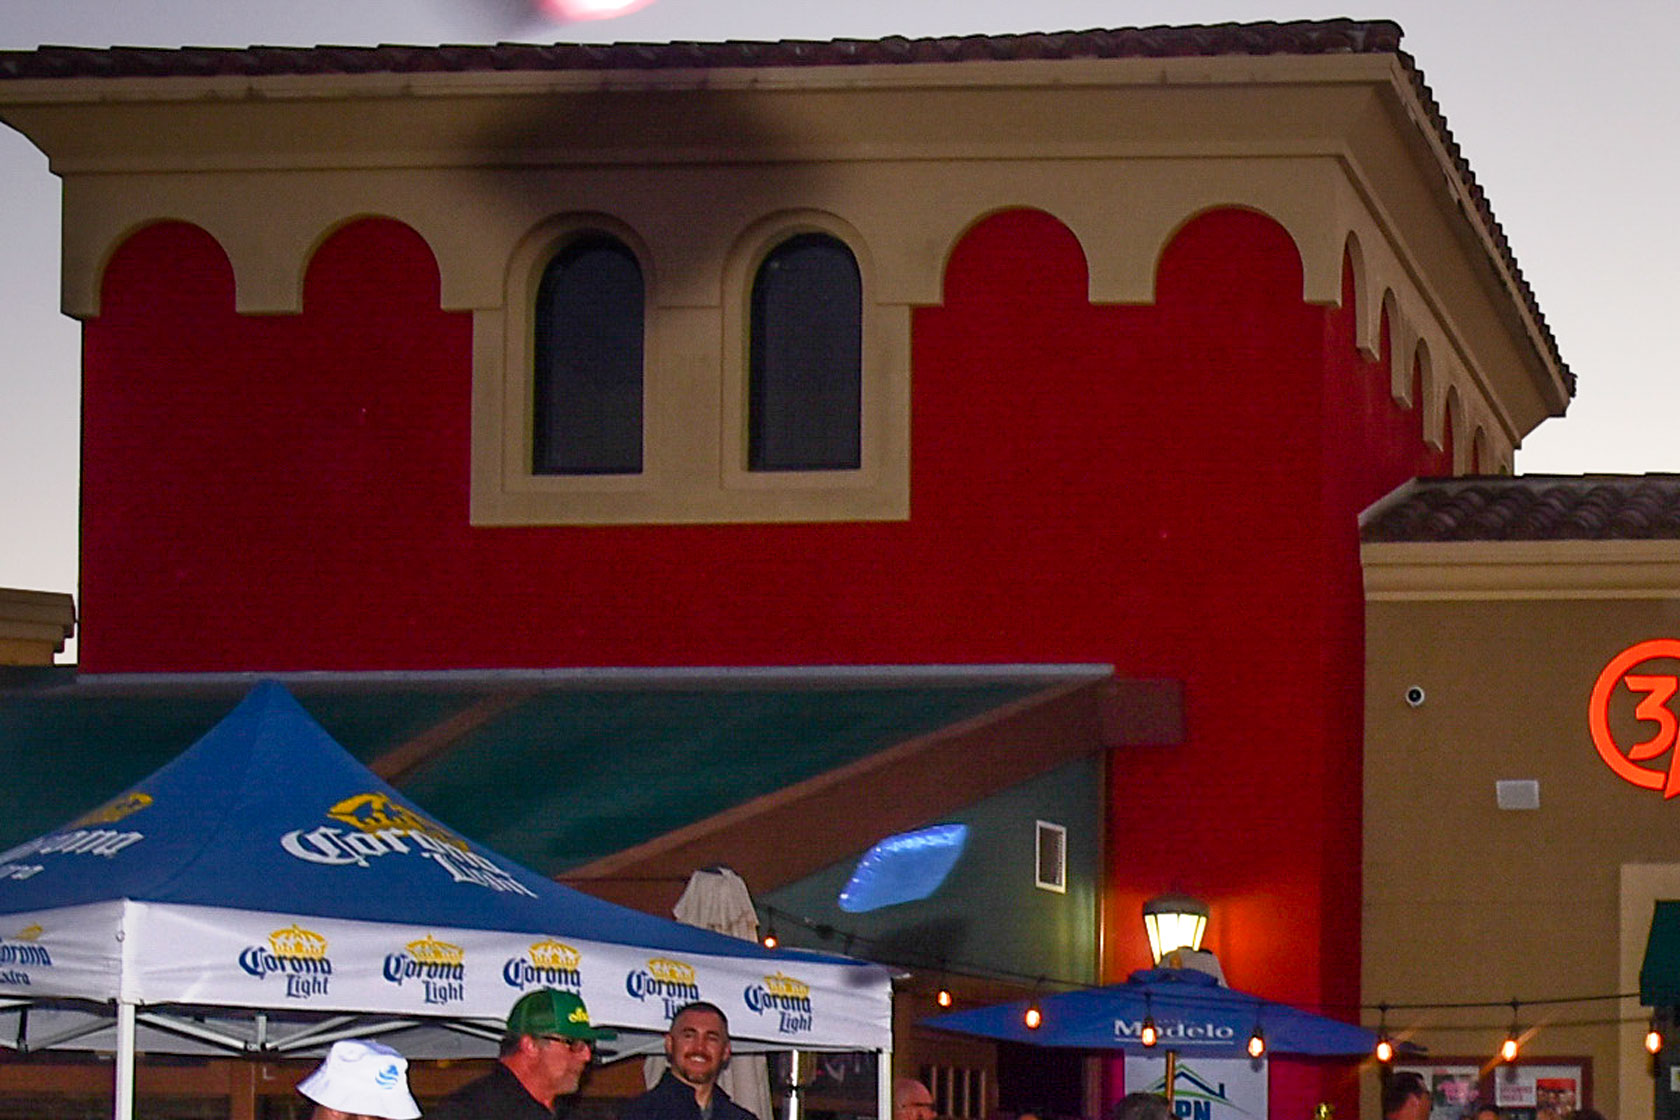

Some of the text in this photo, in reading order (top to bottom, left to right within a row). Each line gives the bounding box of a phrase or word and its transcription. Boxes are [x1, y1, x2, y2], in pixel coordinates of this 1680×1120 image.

[280, 826, 512, 879] Corona
[0, 936, 53, 967] orona
[239, 946, 332, 980] Corona
[383, 952, 464, 986] Corona
[503, 958, 581, 991] Corona
[627, 969, 699, 1002] Corona
[286, 974, 328, 999] Light
[422, 980, 464, 1005] Light
[744, 983, 812, 1016] Corona
[779, 1011, 812, 1034] Light
